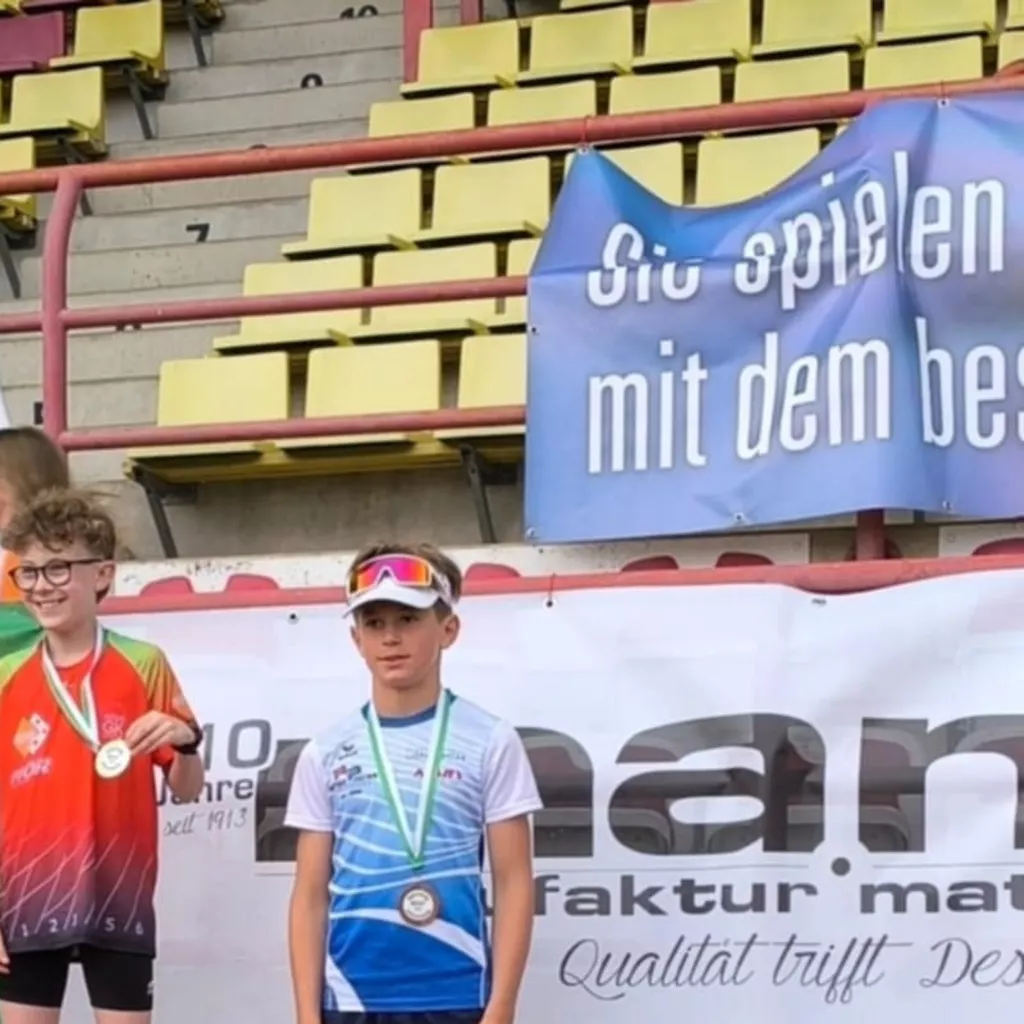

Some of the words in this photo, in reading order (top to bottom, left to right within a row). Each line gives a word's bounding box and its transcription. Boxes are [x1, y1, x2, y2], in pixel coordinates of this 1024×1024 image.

[733, 150, 1004, 310] spielen
[588, 340, 709, 474] mit
[736, 332, 891, 460] dem
[916, 316, 1024, 449] be
[207, 807, 248, 831] 1913
[484, 874, 818, 917] faktur
